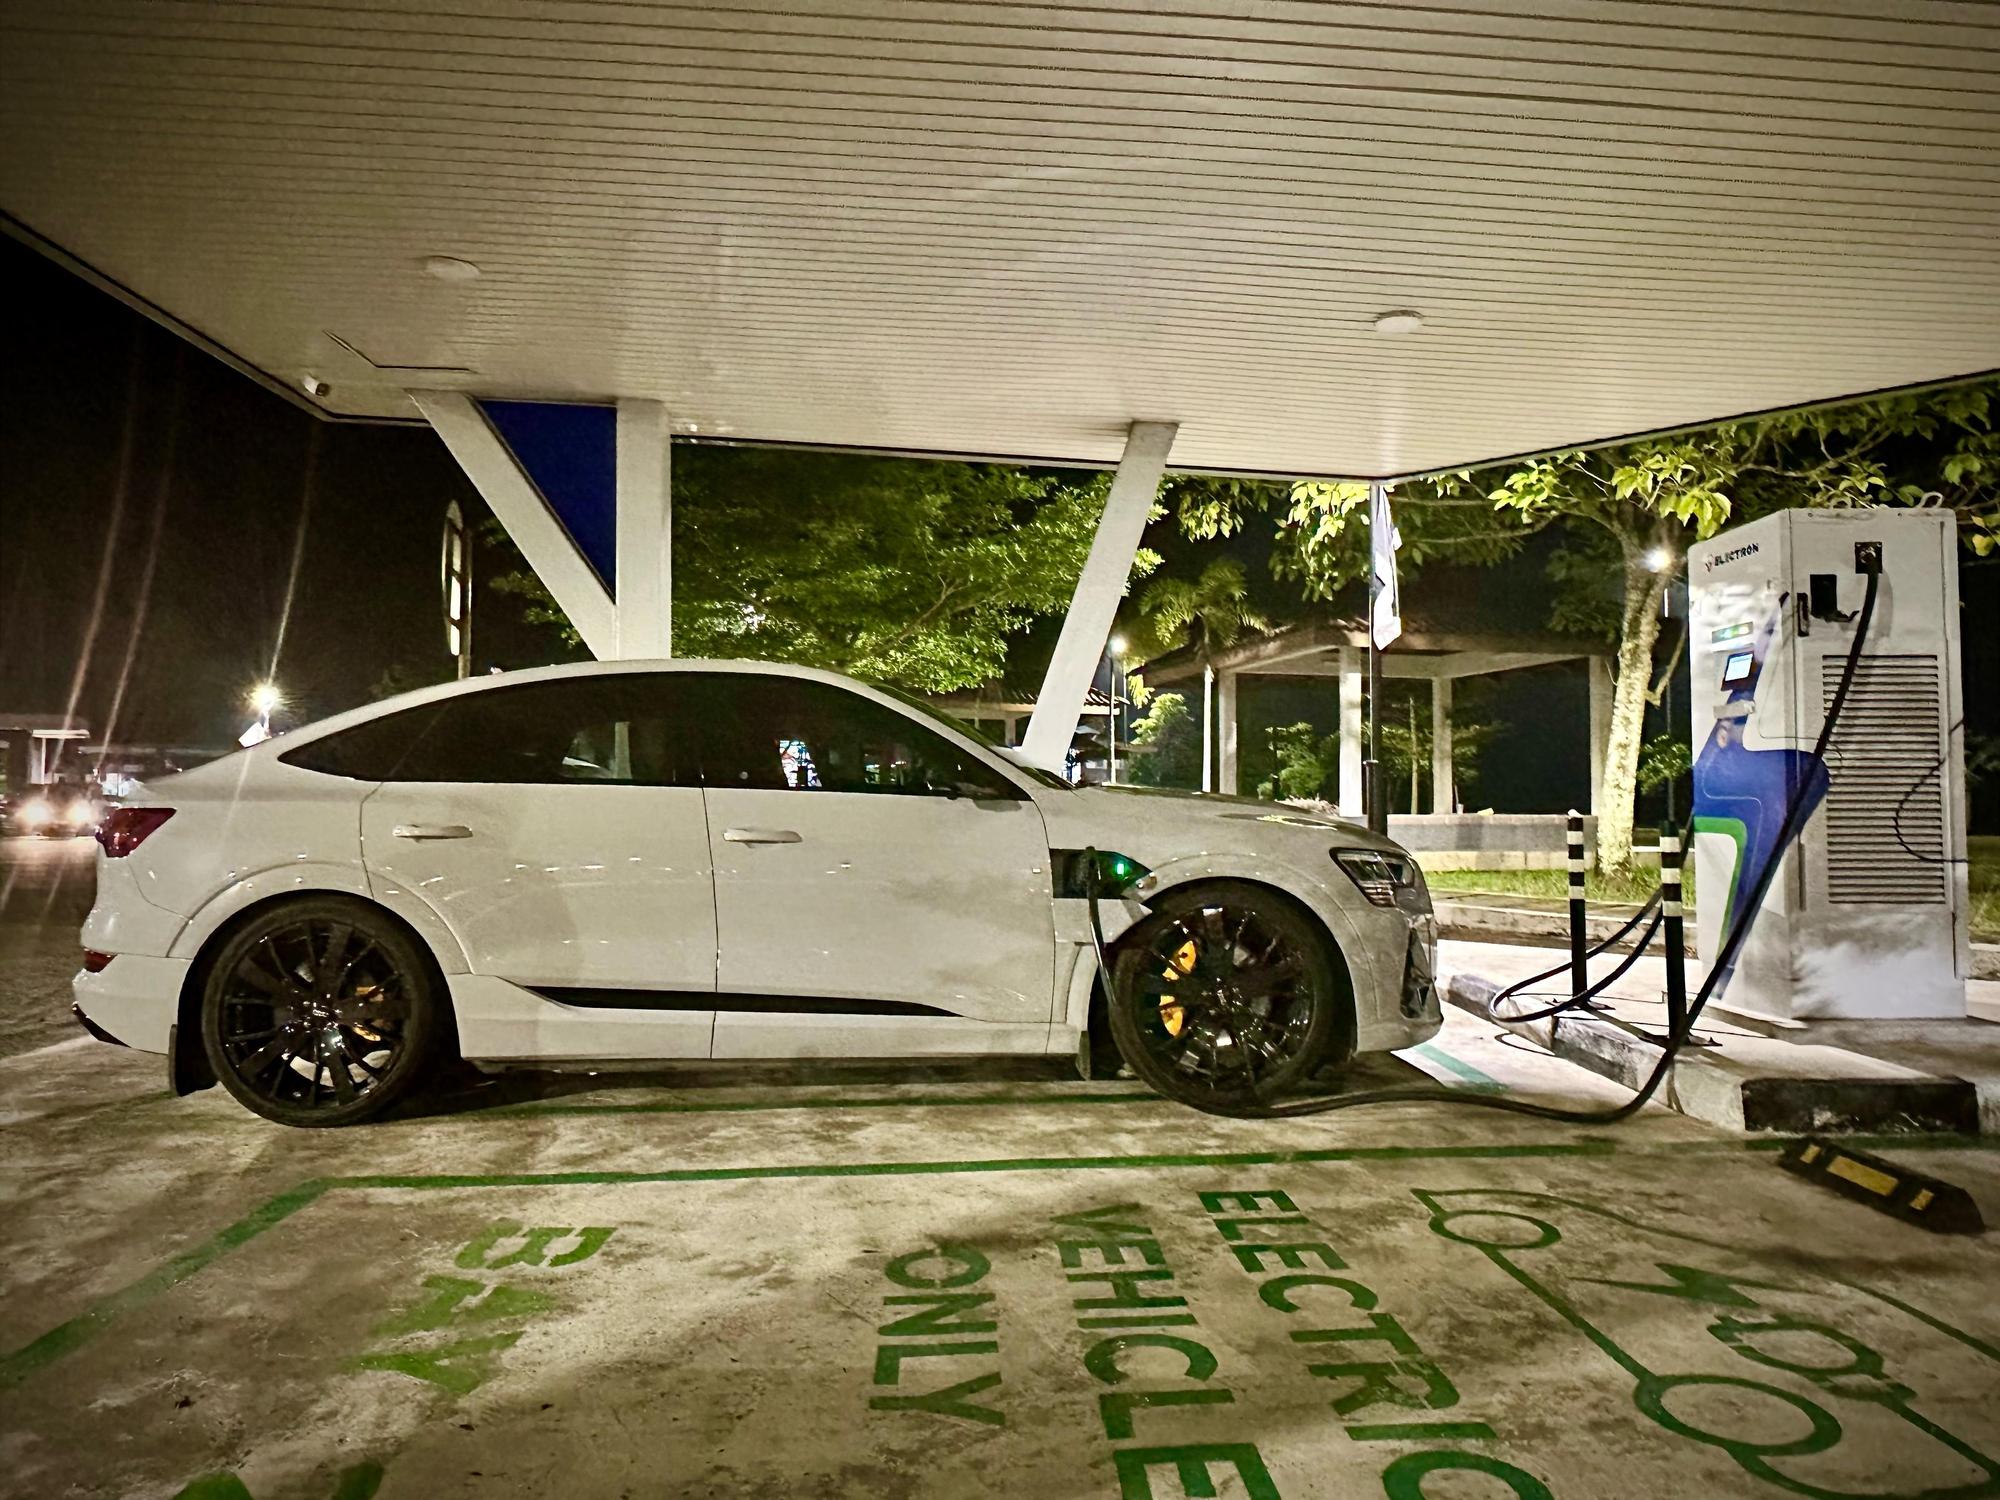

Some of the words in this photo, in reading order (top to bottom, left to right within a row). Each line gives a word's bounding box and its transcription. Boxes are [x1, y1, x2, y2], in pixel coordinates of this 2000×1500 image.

[868, 1243, 1006, 1426] ONLY
[1049, 1202, 1282, 1500] VEHICLE
[1197, 1189, 1556, 1500] ELECTRIC
